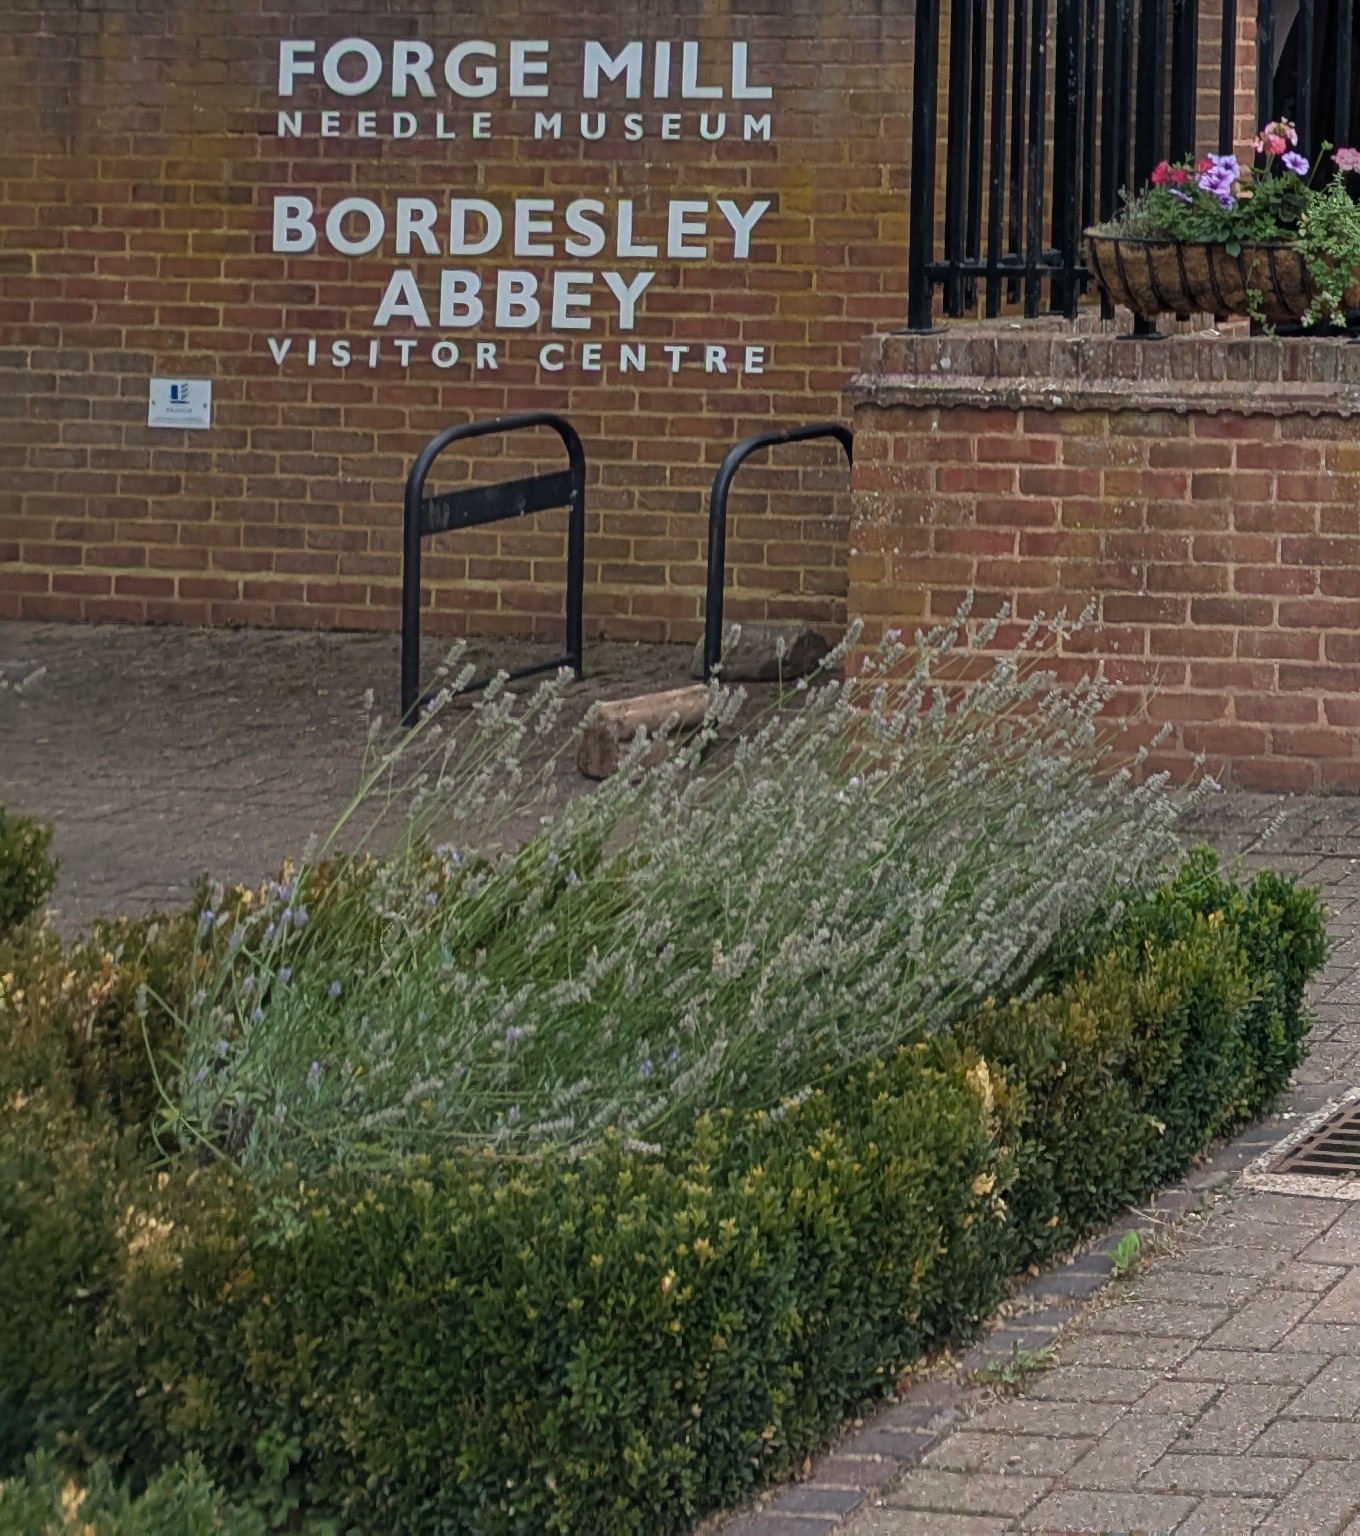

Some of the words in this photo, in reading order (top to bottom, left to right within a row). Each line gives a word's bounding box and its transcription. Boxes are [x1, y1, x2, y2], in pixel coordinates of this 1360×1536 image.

[278, 37, 550, 99] FORGE
[583, 40, 774, 100] MILL
[278, 111, 493, 140] NEEDLE
[535, 112, 773, 142] MUSEUM
[272, 196, 772, 260] BORDESLEY
[373, 270, 657, 331] ABBEY
[268, 339, 499, 370] VISITOR
[540, 343, 766, 375] CENTRE
